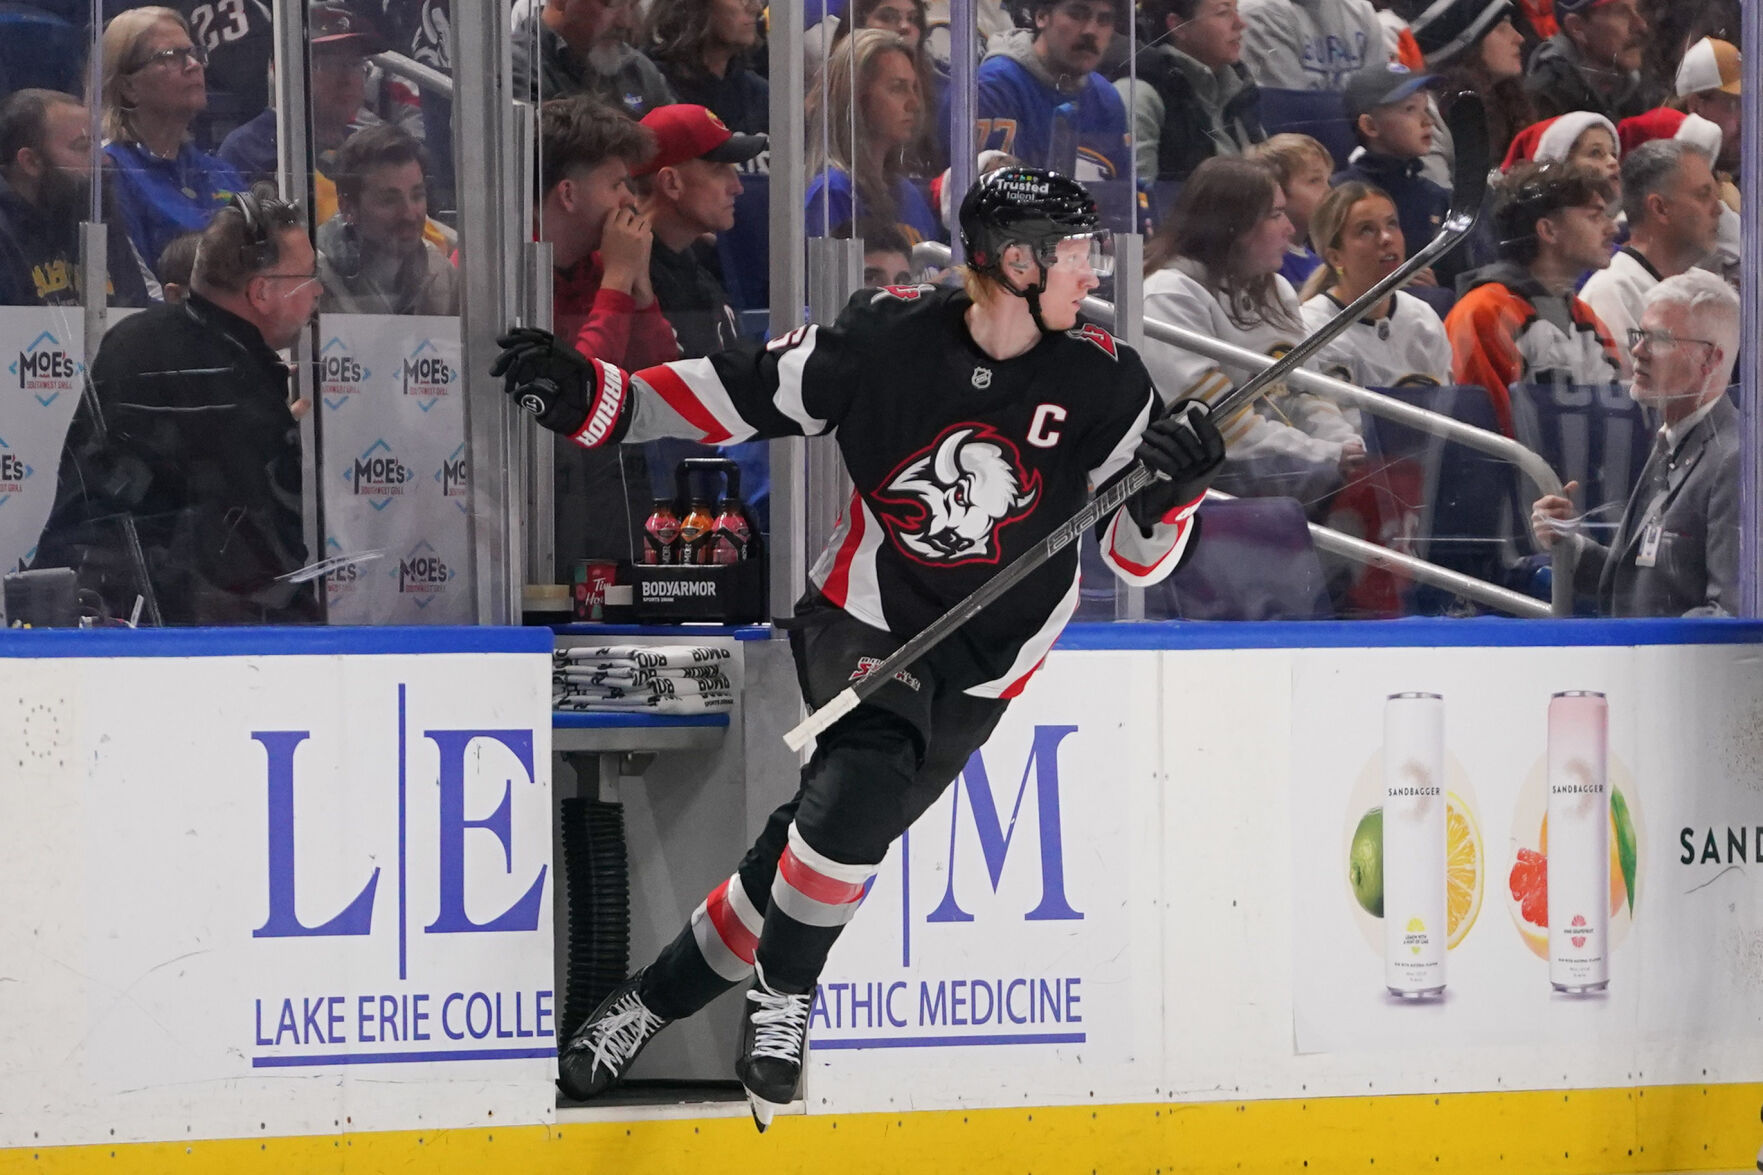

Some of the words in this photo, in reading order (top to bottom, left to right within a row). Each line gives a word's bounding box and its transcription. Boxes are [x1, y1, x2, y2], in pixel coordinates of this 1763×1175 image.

[996, 178, 1050, 195] Trusted
[1006, 190, 1035, 201] talent
[1026, 402, 1068, 448] C
[642, 581, 716, 596] BODYARMOR
[1388, 787, 1441, 797] SANDBAGGER
[1552, 785, 1604, 794] SANDBAGGER
[251, 731, 380, 938] L
[424, 729, 547, 934] E
[926, 725, 1084, 922] M
[255, 996, 347, 1045] LAKE
[358, 994, 431, 1042] ERIE
[441, 991, 555, 1040] COLLE
[809, 982, 907, 1028] ATHIC
[919, 978, 1082, 1026] MEDICINE
